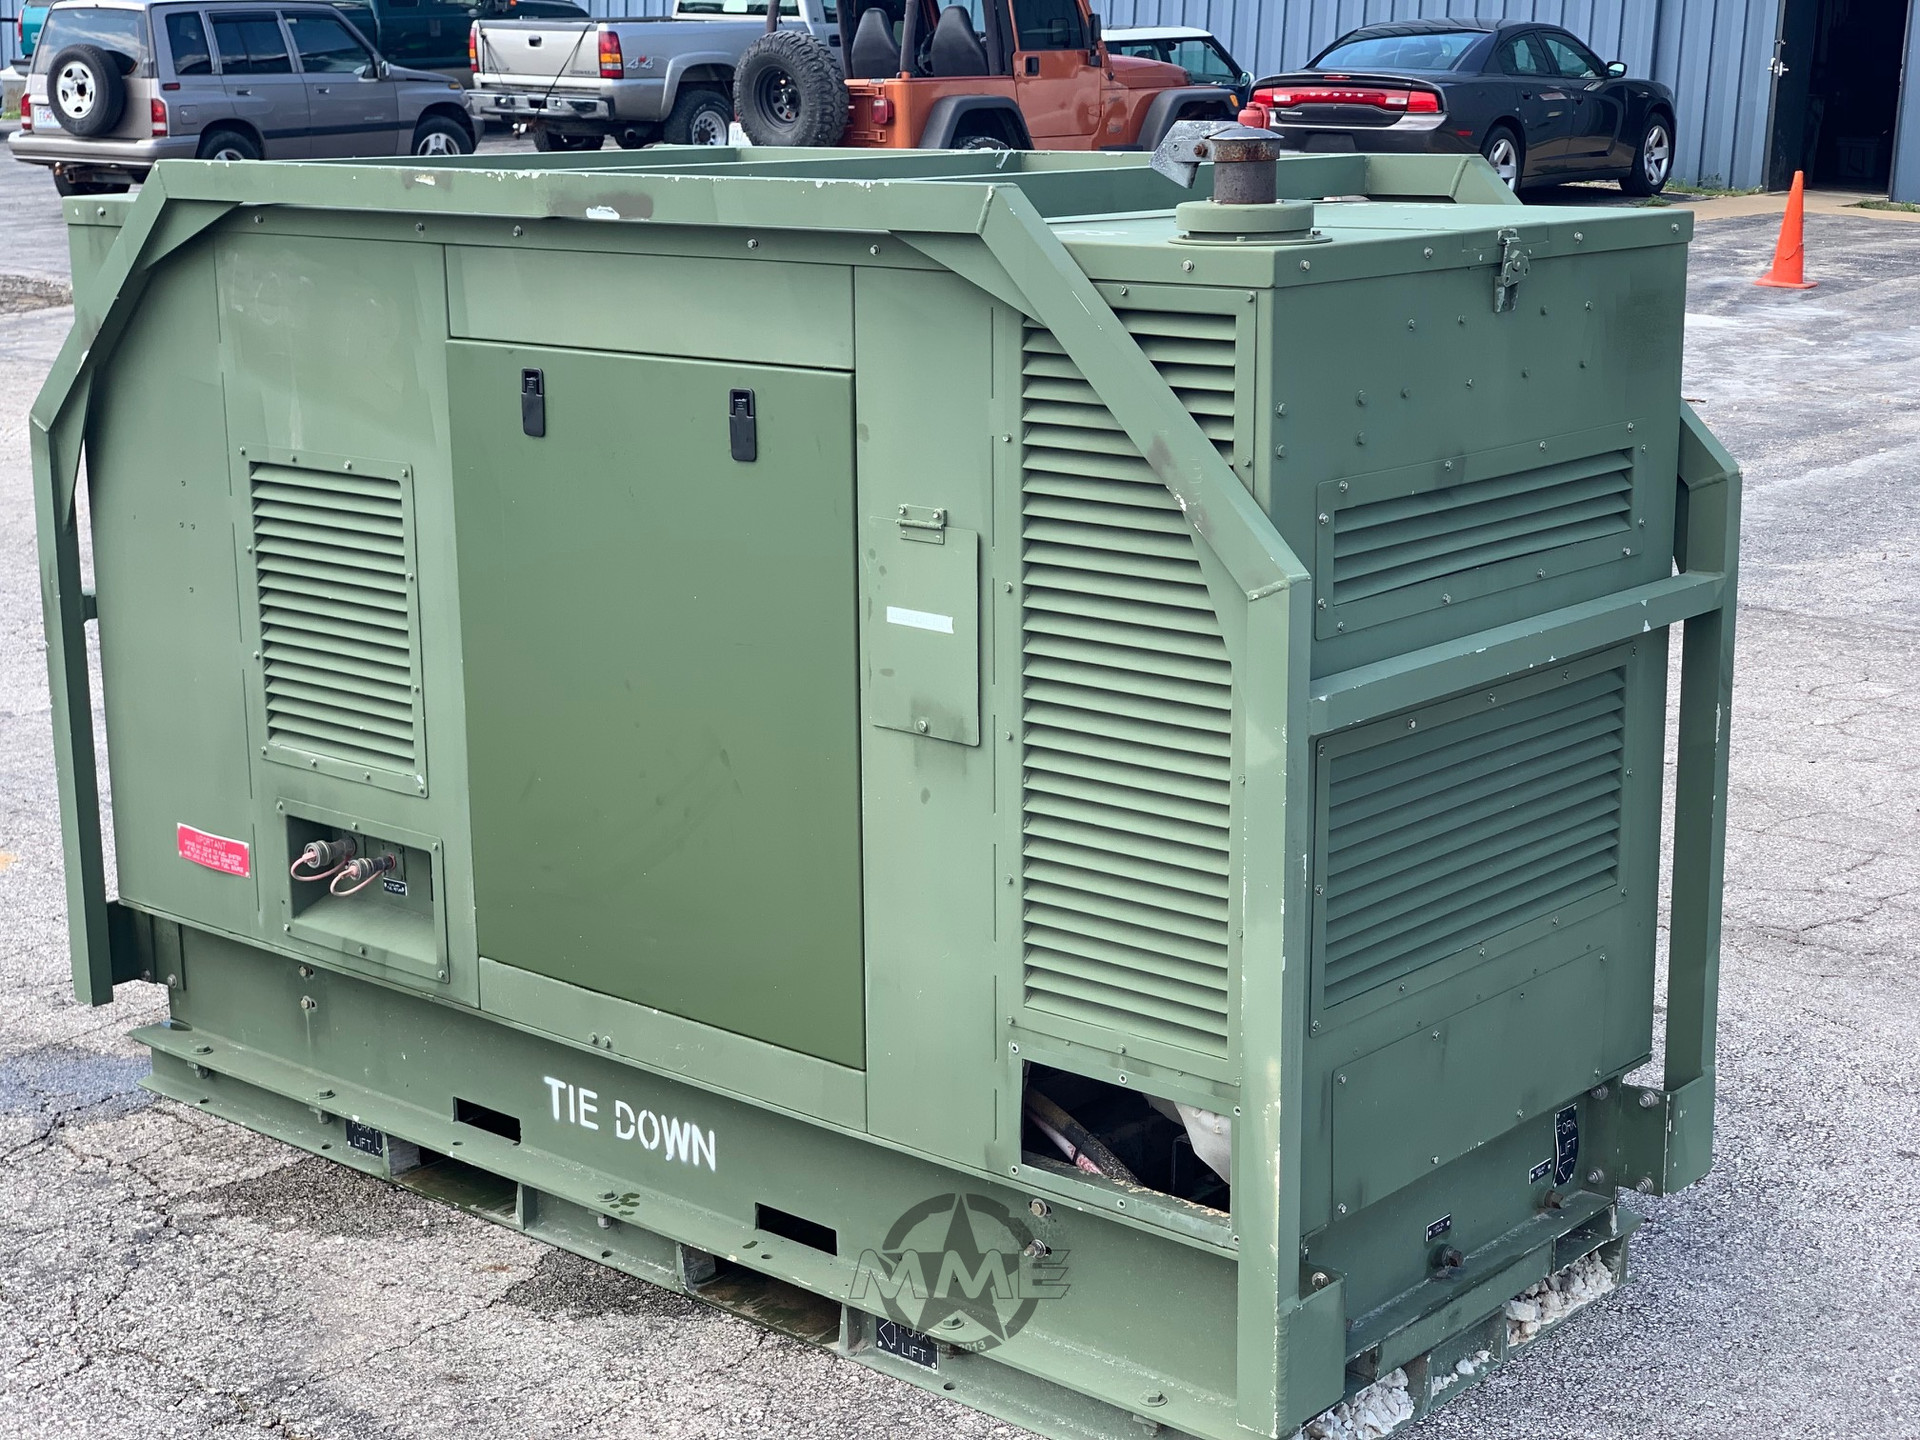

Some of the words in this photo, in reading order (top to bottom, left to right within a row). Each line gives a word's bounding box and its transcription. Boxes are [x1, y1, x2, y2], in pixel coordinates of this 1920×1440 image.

[543, 1075, 600, 1131] TIE
[614, 1099, 717, 1172] DOWN
[1556, 1117, 1577, 1135] FORK
[353, 1135, 373, 1151] LIFT
[1559, 1136, 1577, 1156] LIFT
[901, 1343, 927, 1362] LIFT
